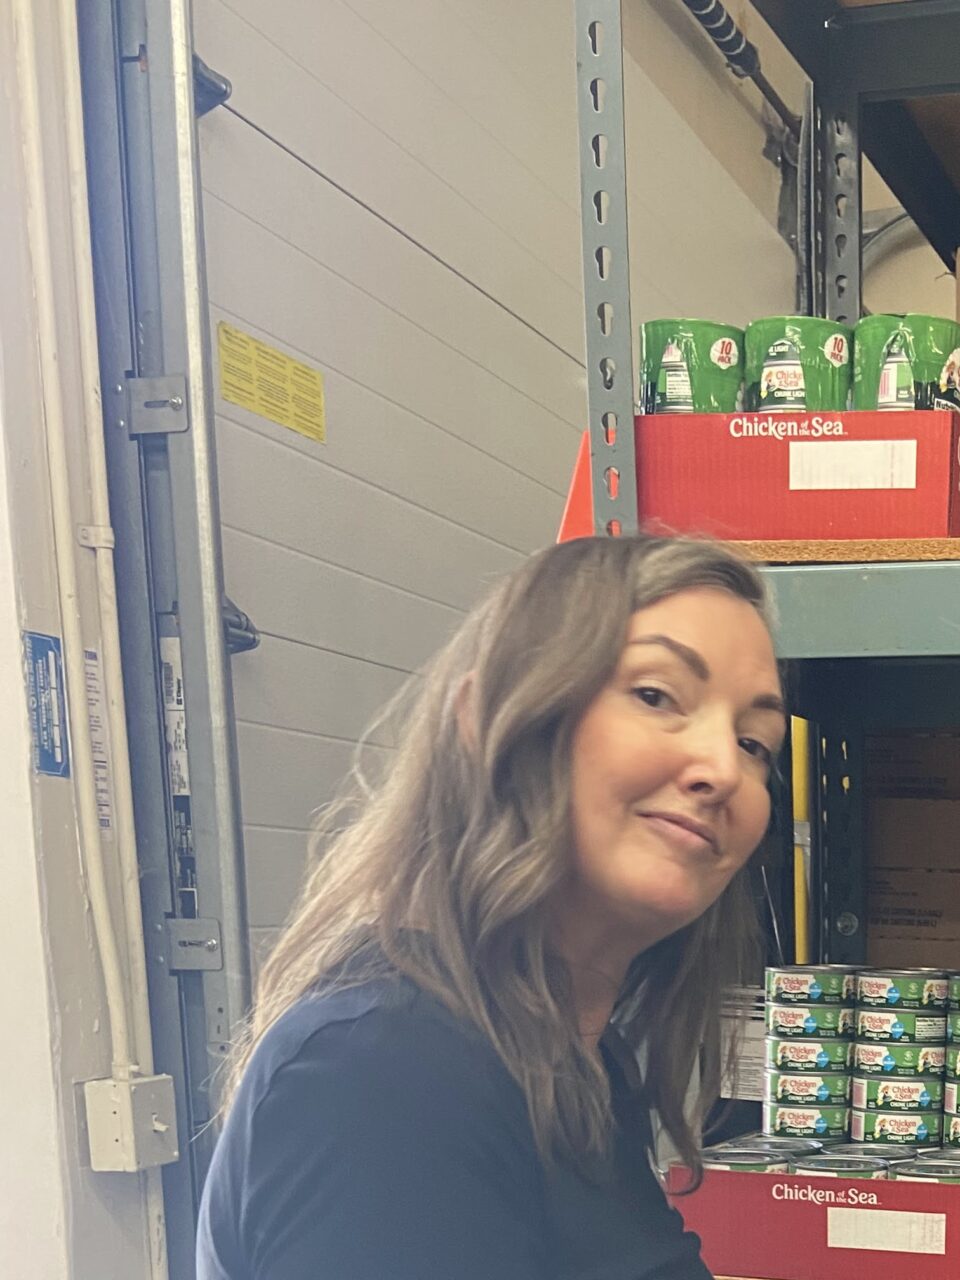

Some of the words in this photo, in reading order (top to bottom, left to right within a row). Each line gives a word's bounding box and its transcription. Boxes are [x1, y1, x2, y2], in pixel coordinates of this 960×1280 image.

[720, 341, 732, 355] 10
[834, 337, 845, 352] 10
[729, 416, 798, 440] Chicken
[811, 416, 844, 436] Sea
[892, 1086, 920, 1095] Chicken
[771, 1183, 836, 1205] Chicken
[847, 1188, 878, 1205] Sea
